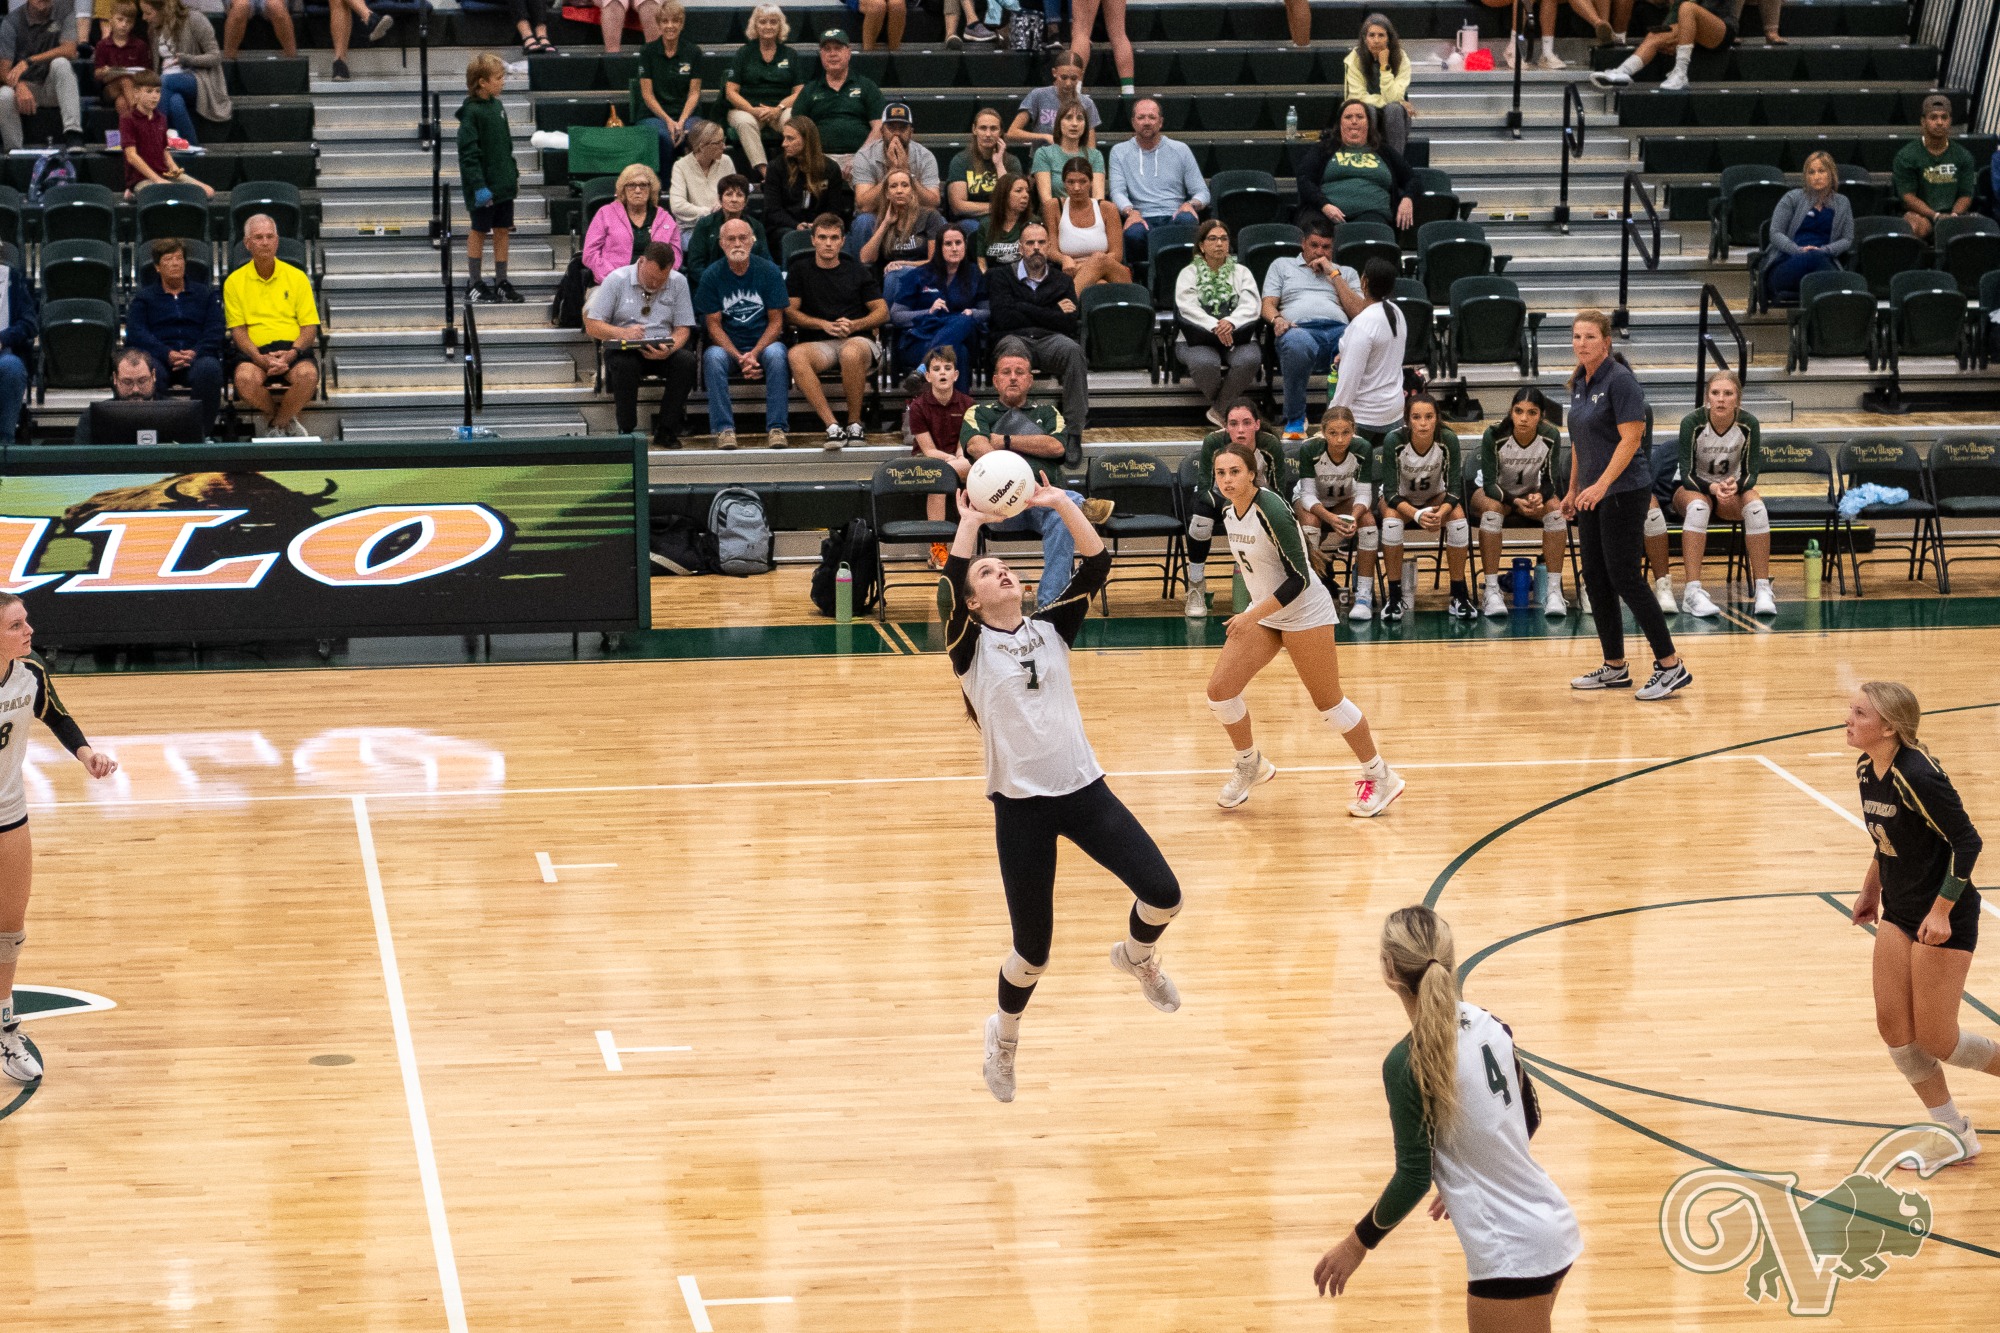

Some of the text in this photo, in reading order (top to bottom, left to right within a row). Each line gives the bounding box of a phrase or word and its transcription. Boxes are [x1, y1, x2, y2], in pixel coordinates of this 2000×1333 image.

[1708, 459, 1730, 475] 13
[1410, 476, 1431, 491] 15
[1516, 470, 1524, 485] 1
[988, 480, 1015, 504] Wilson
[1328, 485, 1345, 497] 11
[1238, 550, 1254, 573] 5
[1019, 659, 1039, 690] 7
[1480, 1041, 1512, 1108] 4
